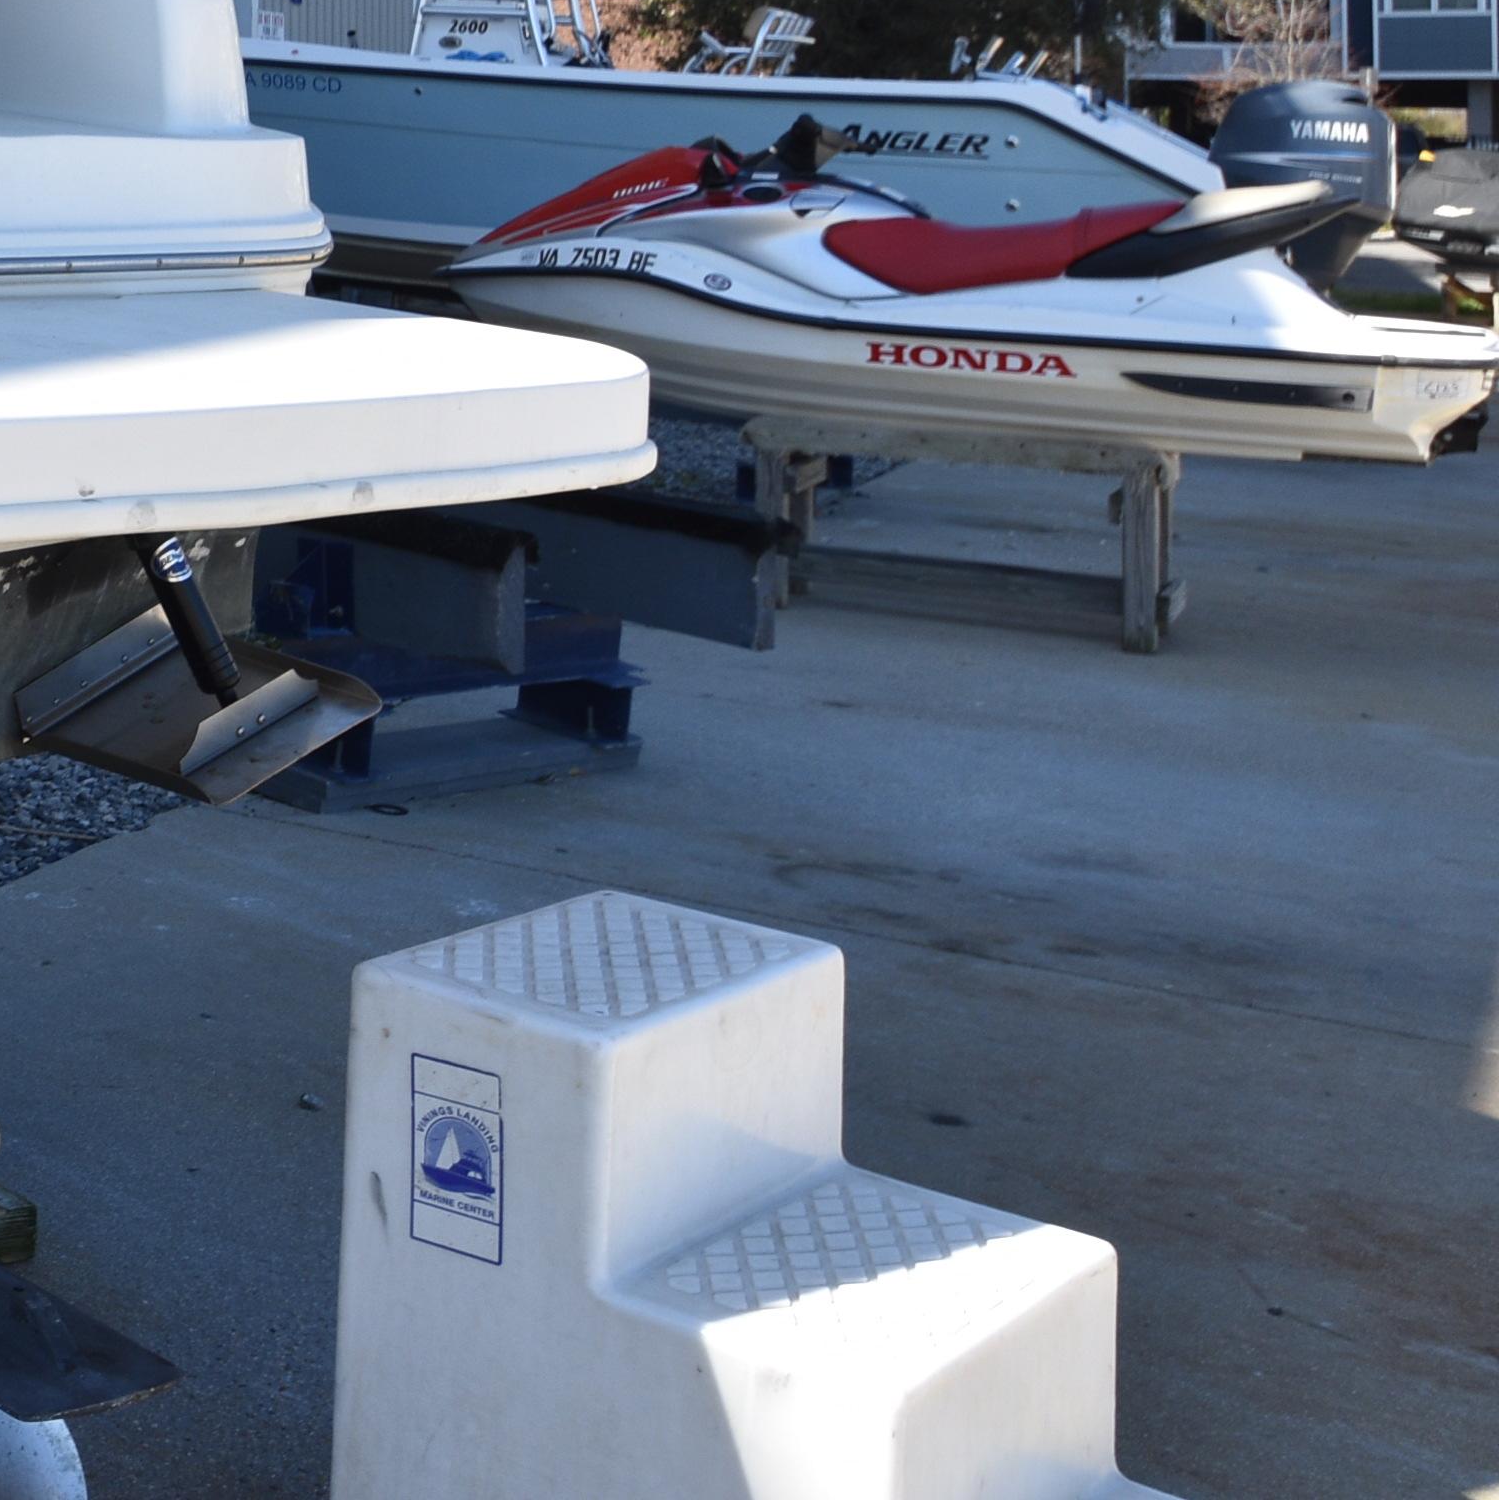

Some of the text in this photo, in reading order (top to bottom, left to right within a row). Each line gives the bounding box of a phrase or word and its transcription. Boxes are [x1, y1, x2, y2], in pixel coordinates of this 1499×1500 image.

[449, 19, 488, 34] 2600
[261, 72, 306, 91] 9089
[312, 75, 343, 94] CD
[1290, 119, 1369, 143] YAMAHA
[538, 248, 559, 267] VA
[569, 247, 621, 268] 7503
[866, 341, 1077, 378] HONDA
[416, 1106, 499, 1154] VININGS LANDING
[419, 1189, 495, 1219] MARINE CENTER
